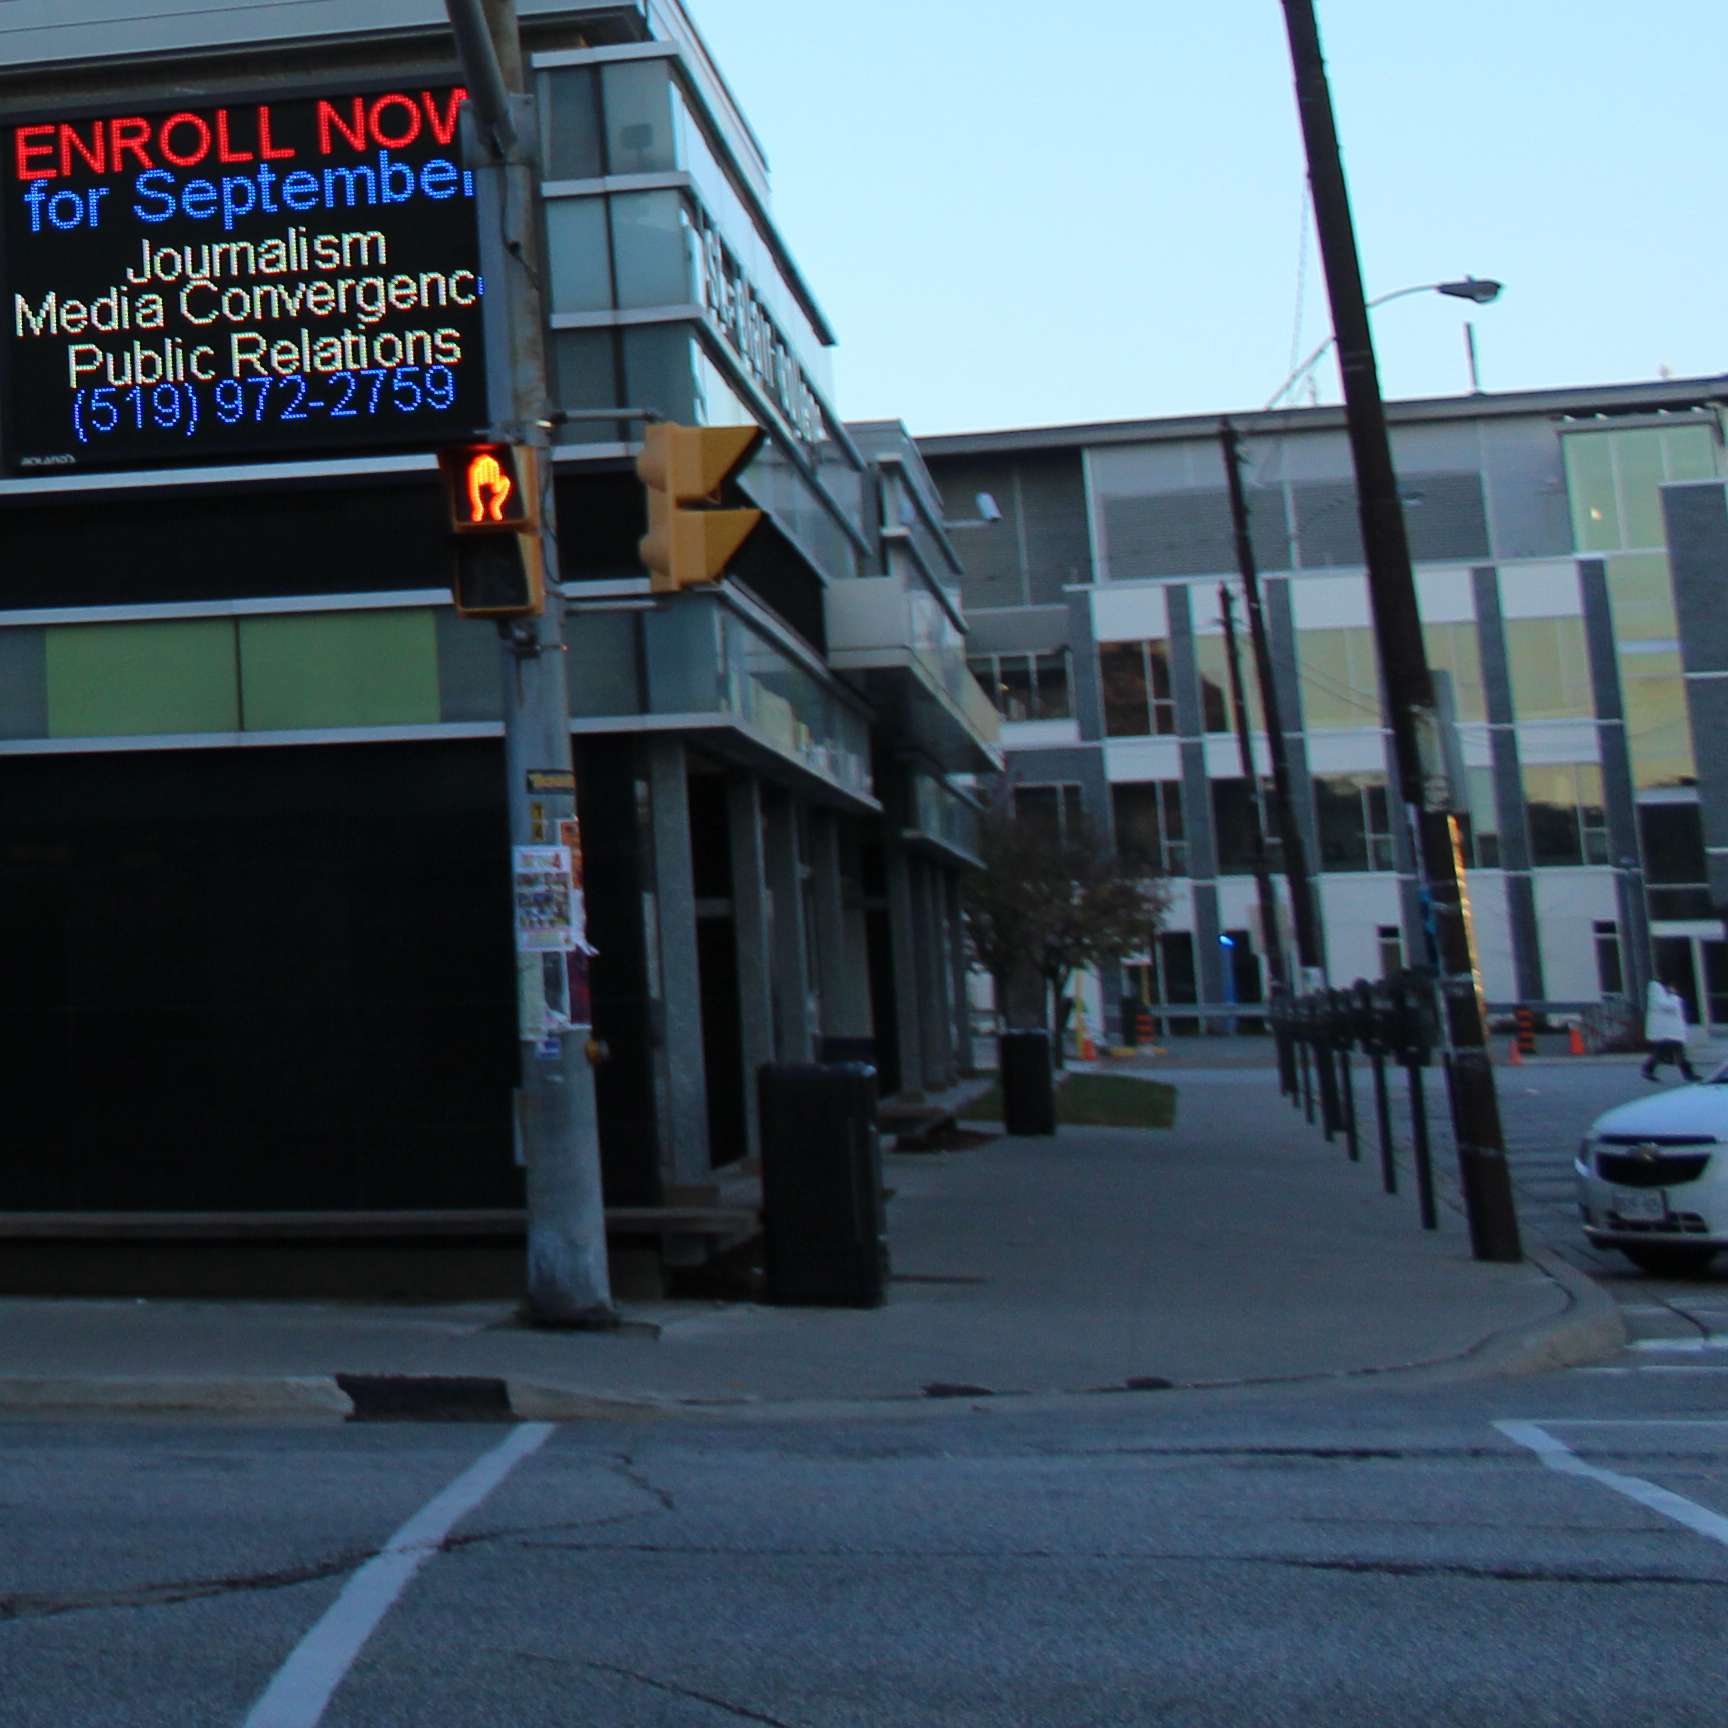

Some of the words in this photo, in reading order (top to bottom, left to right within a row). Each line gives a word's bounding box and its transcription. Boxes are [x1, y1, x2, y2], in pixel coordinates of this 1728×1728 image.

[13, 105, 295, 180] ENROLL
[24, 179, 110, 233] for
[126, 226, 388, 284] Journalism
[14, 285, 165, 337] Media
[180, 269, 485, 325] Convergenc
[68, 337, 216, 389] Public
[230, 324, 462, 379] Relations
[72, 382, 198, 443] (519)
[215, 365, 454, 426] 972-2759
